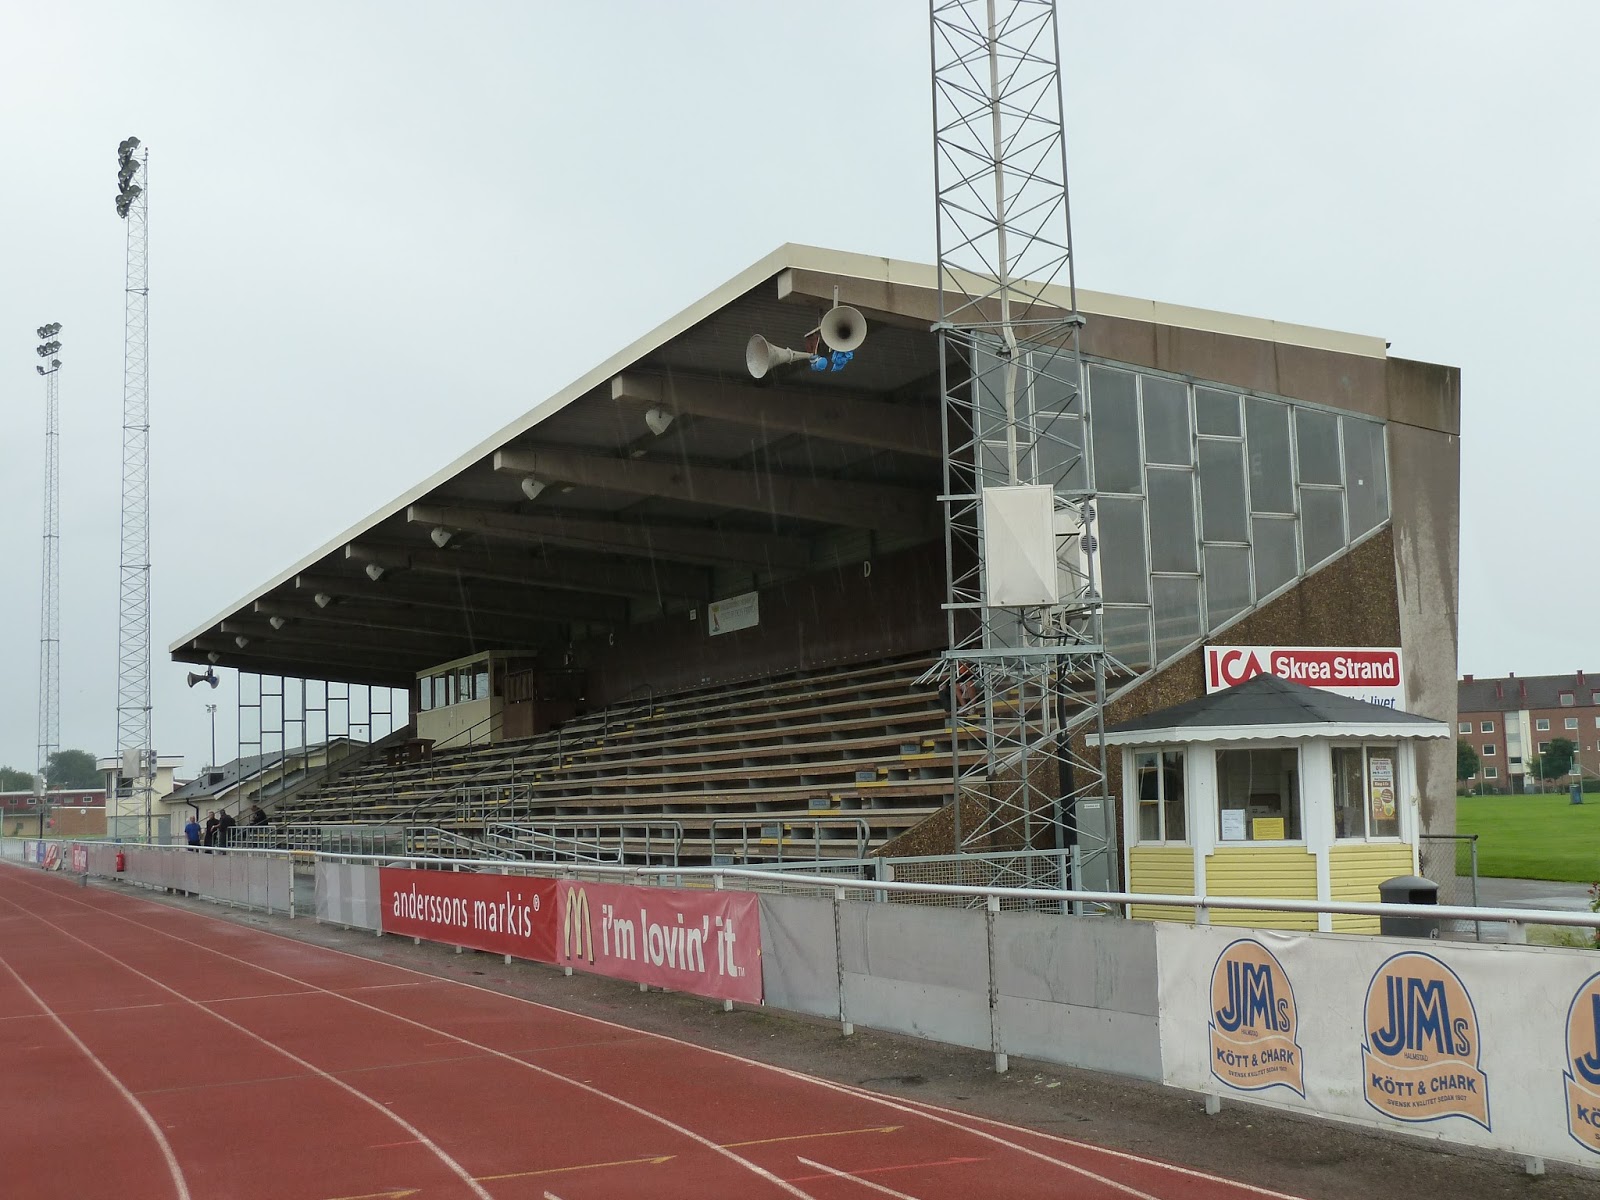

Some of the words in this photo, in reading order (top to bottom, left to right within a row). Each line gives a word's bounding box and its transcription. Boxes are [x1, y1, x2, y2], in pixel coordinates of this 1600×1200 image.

[1209, 650, 1264, 687] ICA
[1276, 656, 1331, 680] Skrea
[1334, 656, 1395, 680] Strand
[393, 882, 468, 928] anderssons
[1216, 1047, 1249, 1068] KÖTT
[1251, 1053, 1259, 1067] &
[1260, 1048, 1295, 1066] CHARK
[1371, 1072, 1414, 1097] KÖTT
[1417, 1080, 1427, 1096] &
[1430, 1074, 1478, 1094] CHARK
